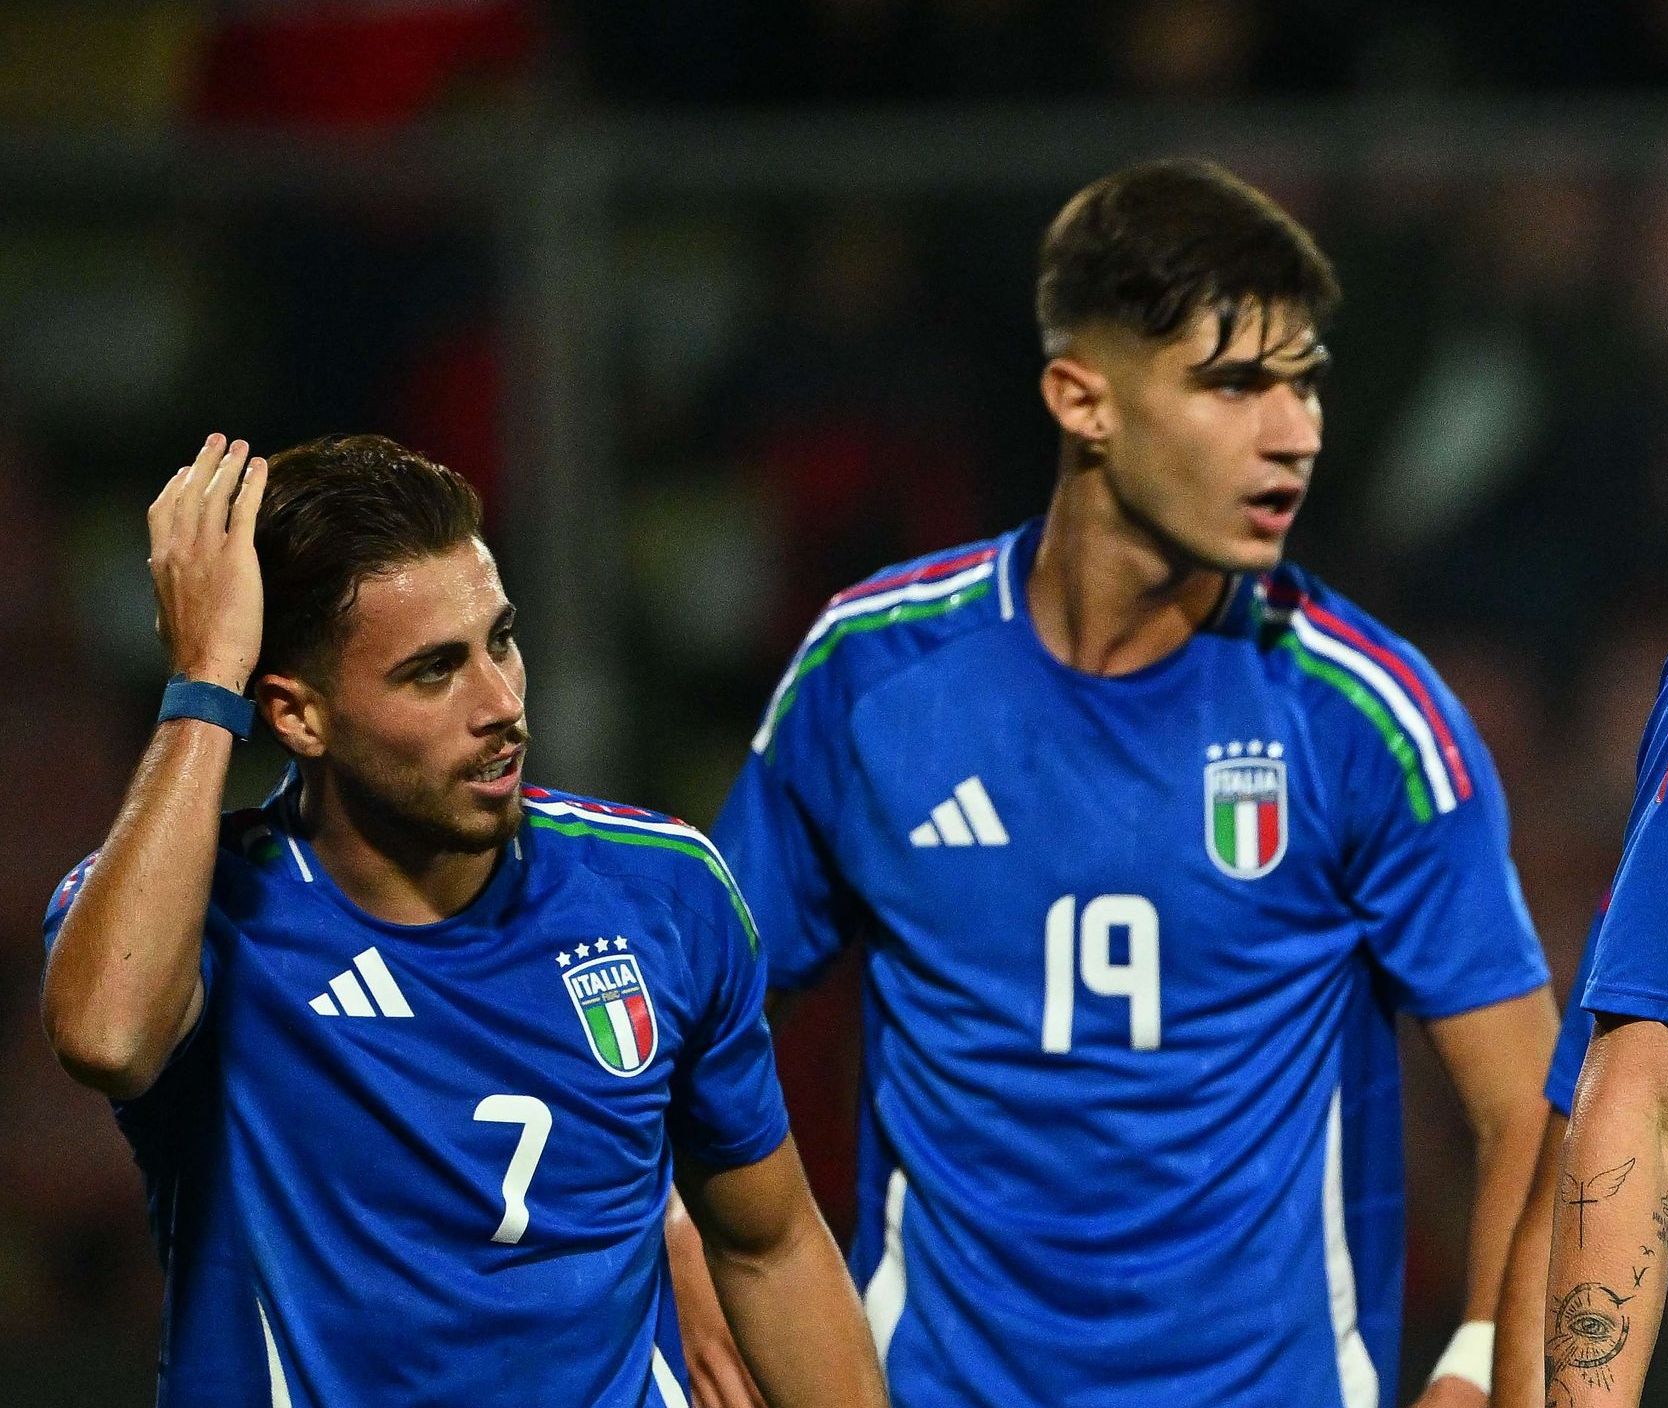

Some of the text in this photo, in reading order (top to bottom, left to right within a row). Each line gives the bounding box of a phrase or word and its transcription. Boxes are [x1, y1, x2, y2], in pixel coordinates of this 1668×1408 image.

[571, 963, 638, 999] ITALIA
[1041, 894, 1161, 1054] 19
[473, 1095, 553, 1244] 7
